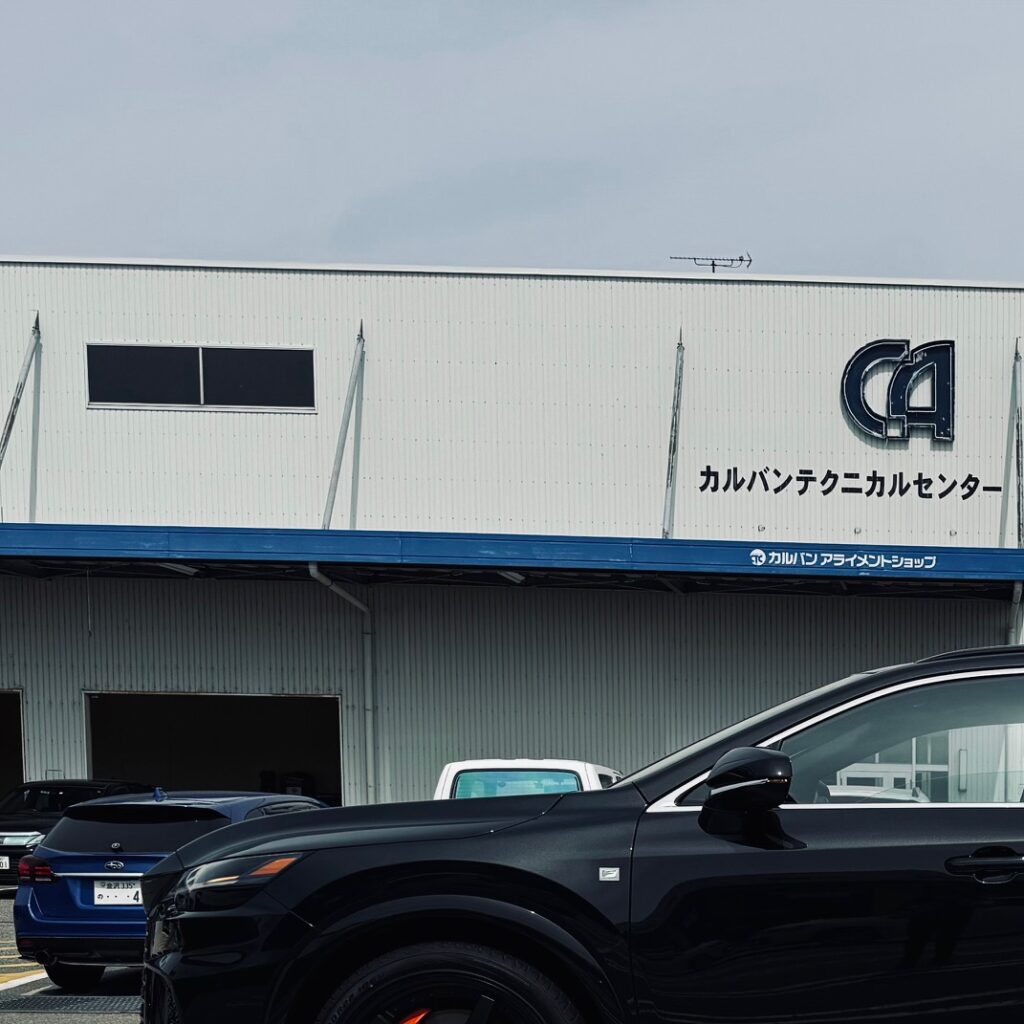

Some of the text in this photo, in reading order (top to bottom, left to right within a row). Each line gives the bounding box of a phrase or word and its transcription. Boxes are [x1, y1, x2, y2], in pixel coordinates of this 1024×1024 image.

[699, 465, 1002, 500] カルバンテクニカルセンター
[768, 551, 817, 566] カルバン
[820, 553, 937, 568] アライメントショップ
